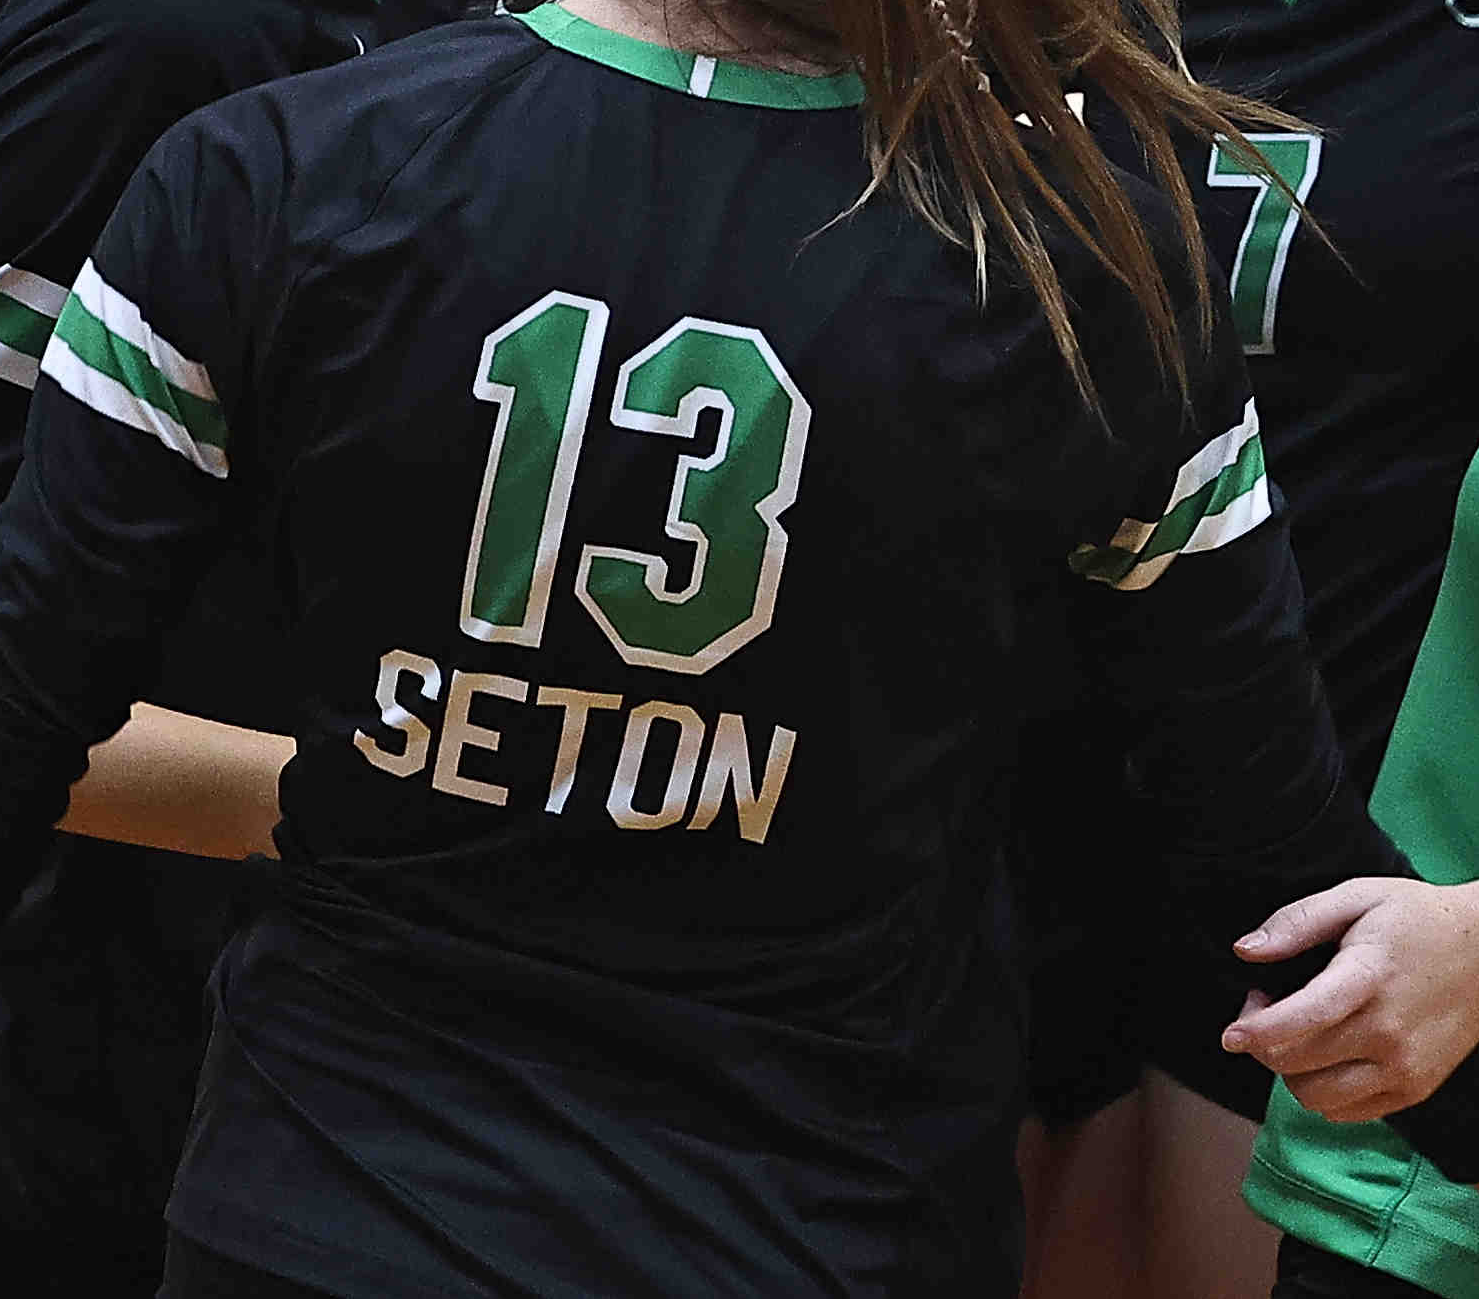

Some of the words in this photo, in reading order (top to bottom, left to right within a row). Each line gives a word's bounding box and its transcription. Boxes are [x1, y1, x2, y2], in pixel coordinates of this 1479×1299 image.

[1207, 132, 1322, 356] 7
[459, 289, 812, 675] 13
[354, 648, 798, 845] SETON
